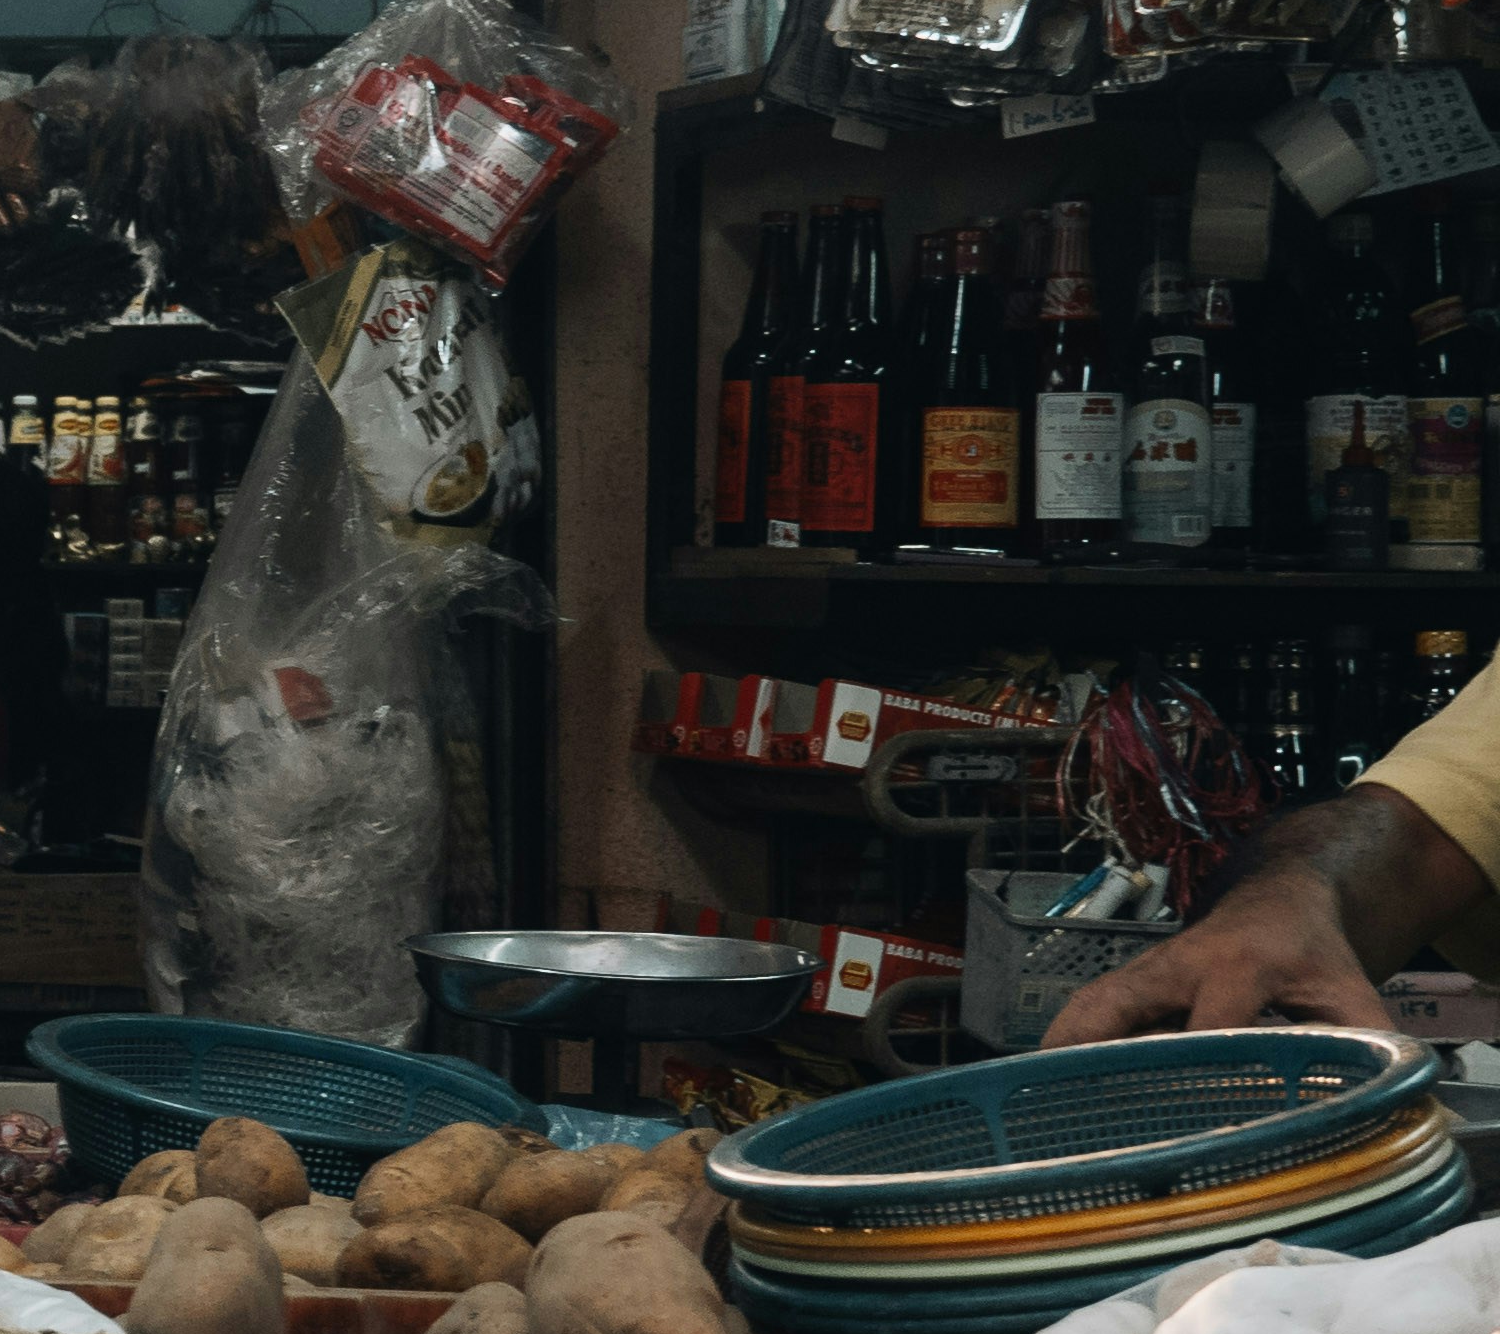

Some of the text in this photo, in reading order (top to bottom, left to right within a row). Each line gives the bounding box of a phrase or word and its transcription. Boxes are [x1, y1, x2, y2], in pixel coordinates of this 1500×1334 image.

[884, 693, 922, 712] BABA
[923, 700, 992, 726] PRODUCTS
[885, 942, 925, 960] BABA
